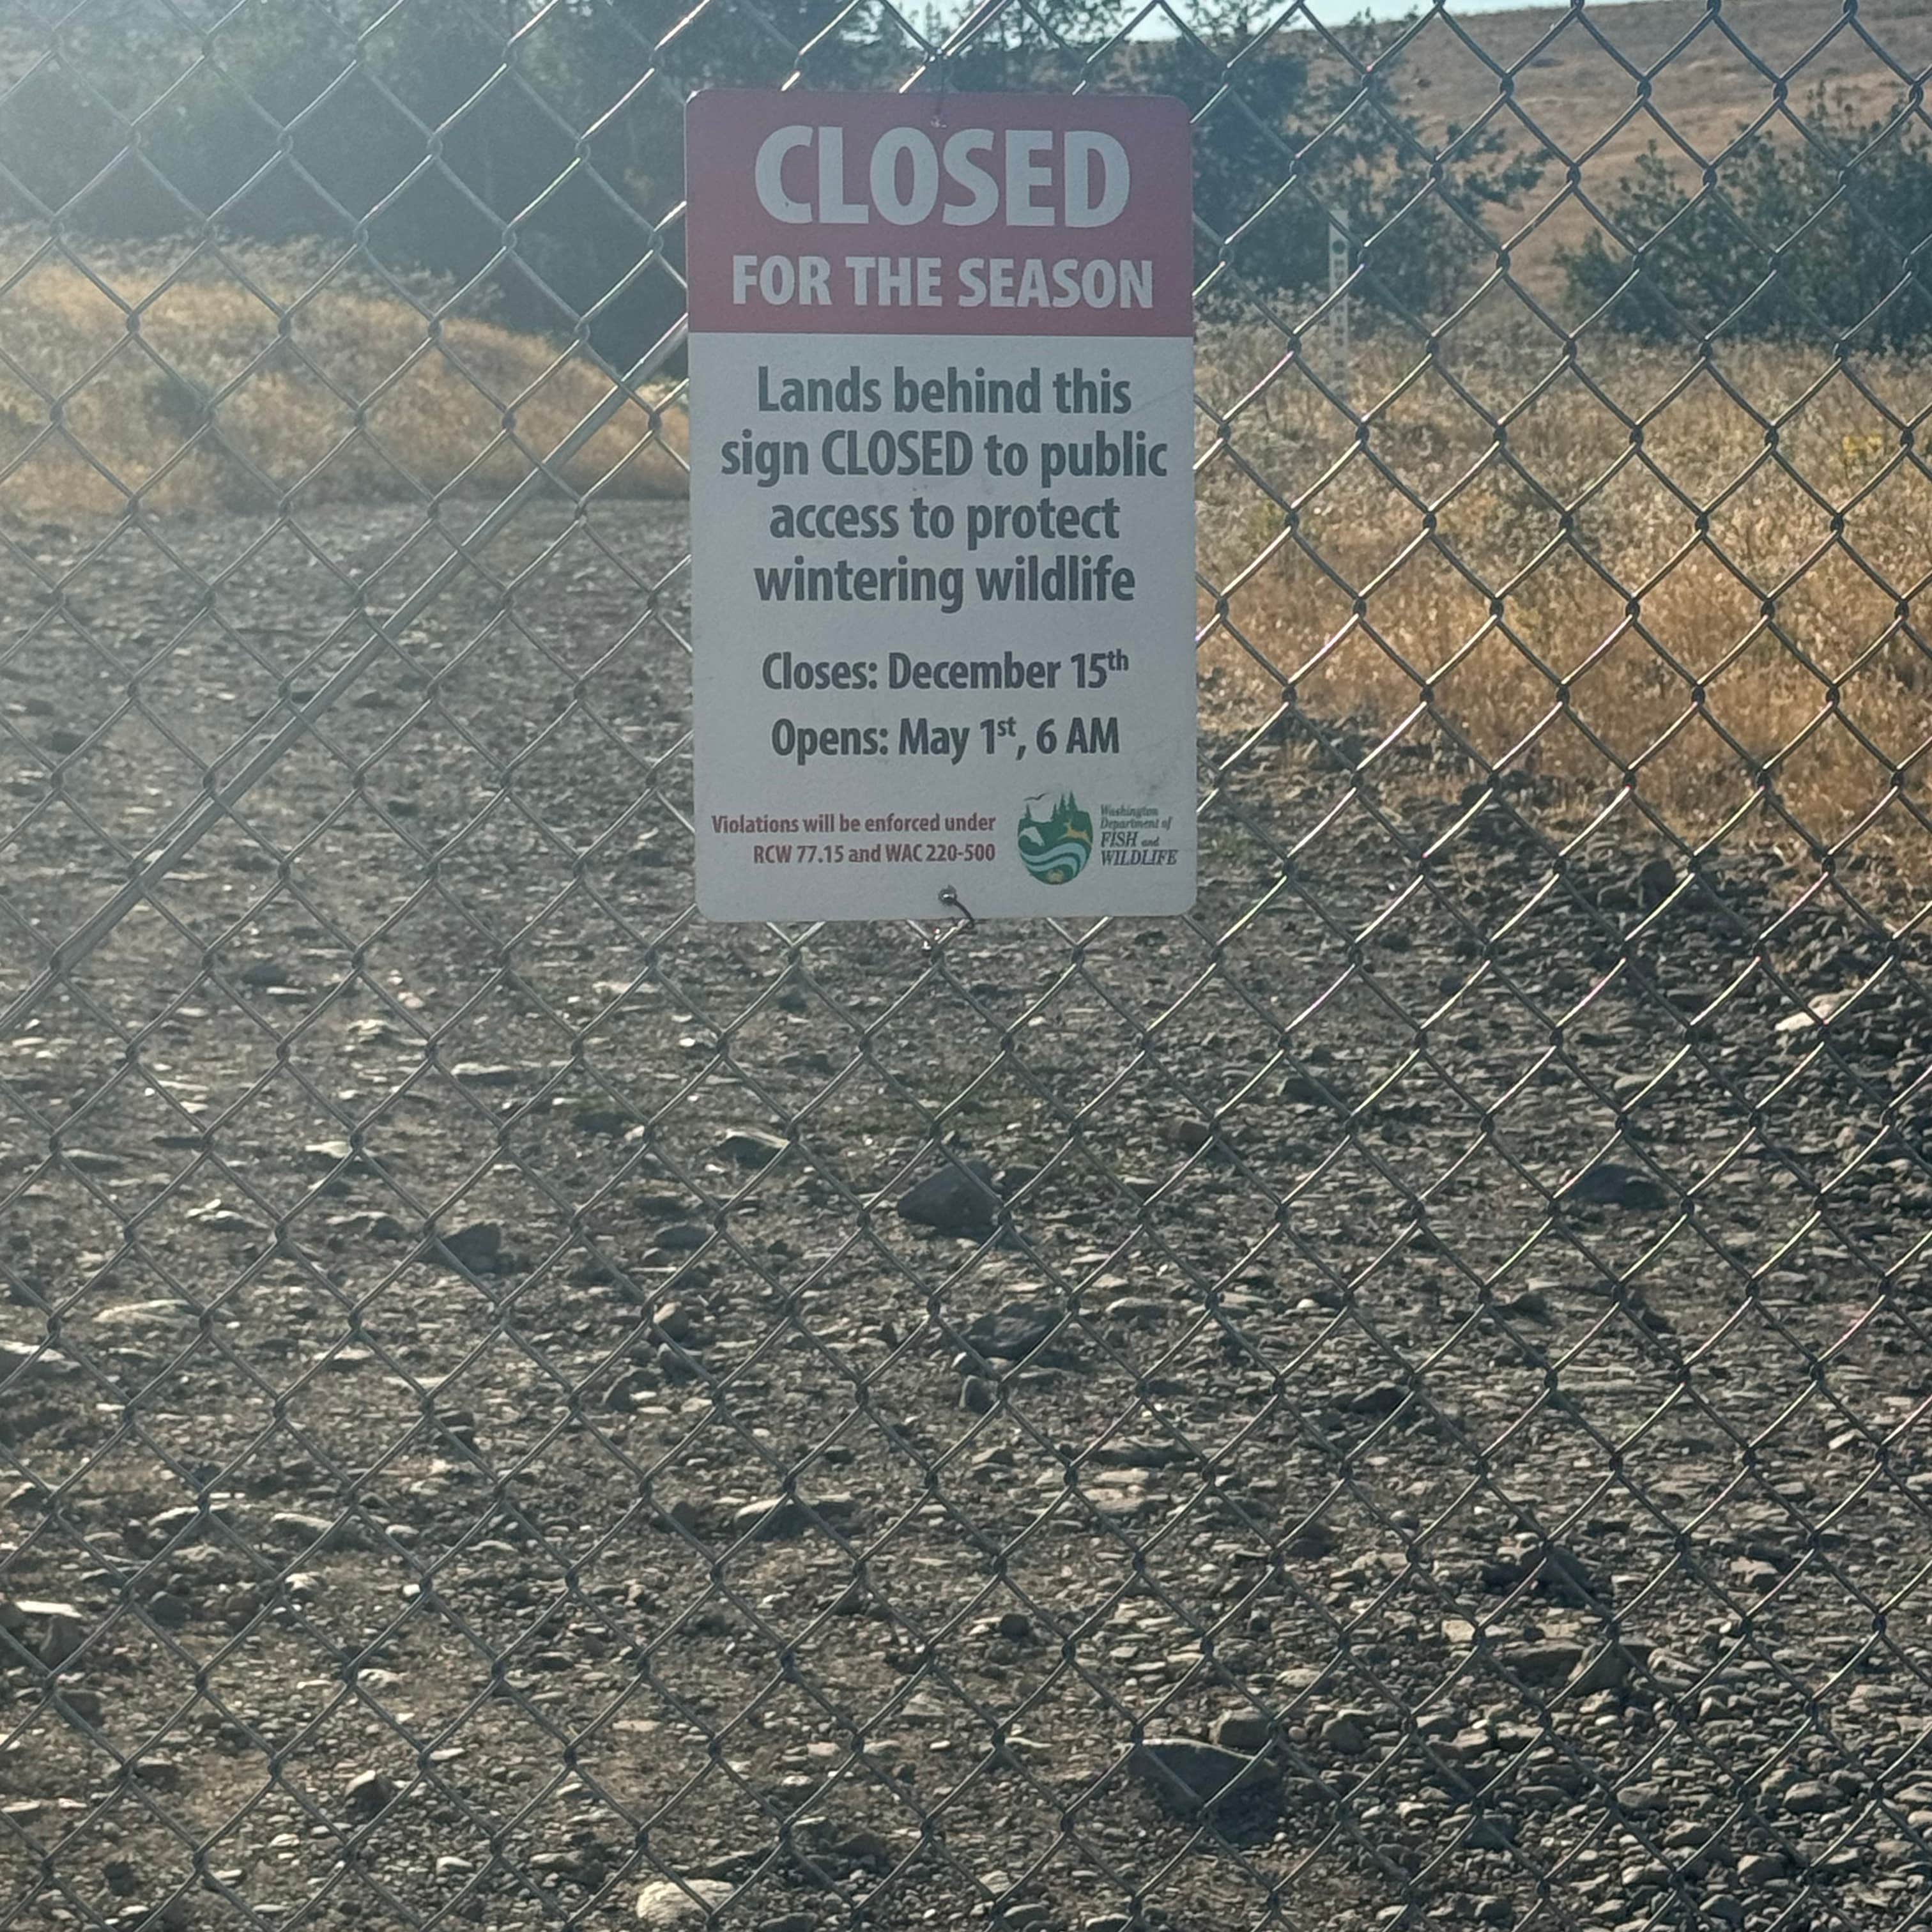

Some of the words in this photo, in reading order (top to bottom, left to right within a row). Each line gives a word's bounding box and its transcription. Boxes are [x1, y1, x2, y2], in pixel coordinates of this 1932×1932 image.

[755, 125, 1131, 227] CLOSED
[732, 255, 832, 307] FOR
[846, 256, 942, 307] THE
[958, 258, 1153, 309] SEASON
[758, 365, 881, 413] Lands
[894, 365, 1040, 414] behind
[1053, 367, 1131, 414] this
[721, 429, 809, 487] sign
[821, 430, 973, 477] CLOSED
[984, 434, 1028, 477] to
[1041, 430, 1168, 488] public
[769, 504, 900, 539] access
[909, 497, 954, 539] to
[967, 497, 1120, 551] protect
[753, 556, 963, 613] wintering
[976, 555, 1136, 602] wildlife
[762, 651, 878, 690] Closes:
[889, 650, 1061, 689] December
[1071, 648, 1130, 689] 15th
[772, 718, 889, 765] Opens:
[898, 717, 970, 765] May
[1036, 719, 1057, 754] 6
[1066, 717, 1120, 754] AM
[711, 815, 799, 833] Violations
[802, 814, 834, 832] will
[839, 813, 860, 831] be
[864, 813, 940, 831] enforced
[945, 813, 996, 831] under
[1100, 804, 1159, 818] Washington
[1100, 817, 1159, 832] Department
[1161, 816, 1173, 831] of
[753, 845, 792, 863] RCW
[797, 845, 843, 862] 77.15
[848, 844, 881, 862] and
[886, 843, 923, 862] WAC
[926, 843, 995, 862] 220-500
[1100, 832, 1138, 847] FISH
[1141, 836, 1160, 847] and
[1101, 849, 1179, 866] WILDLIFE
